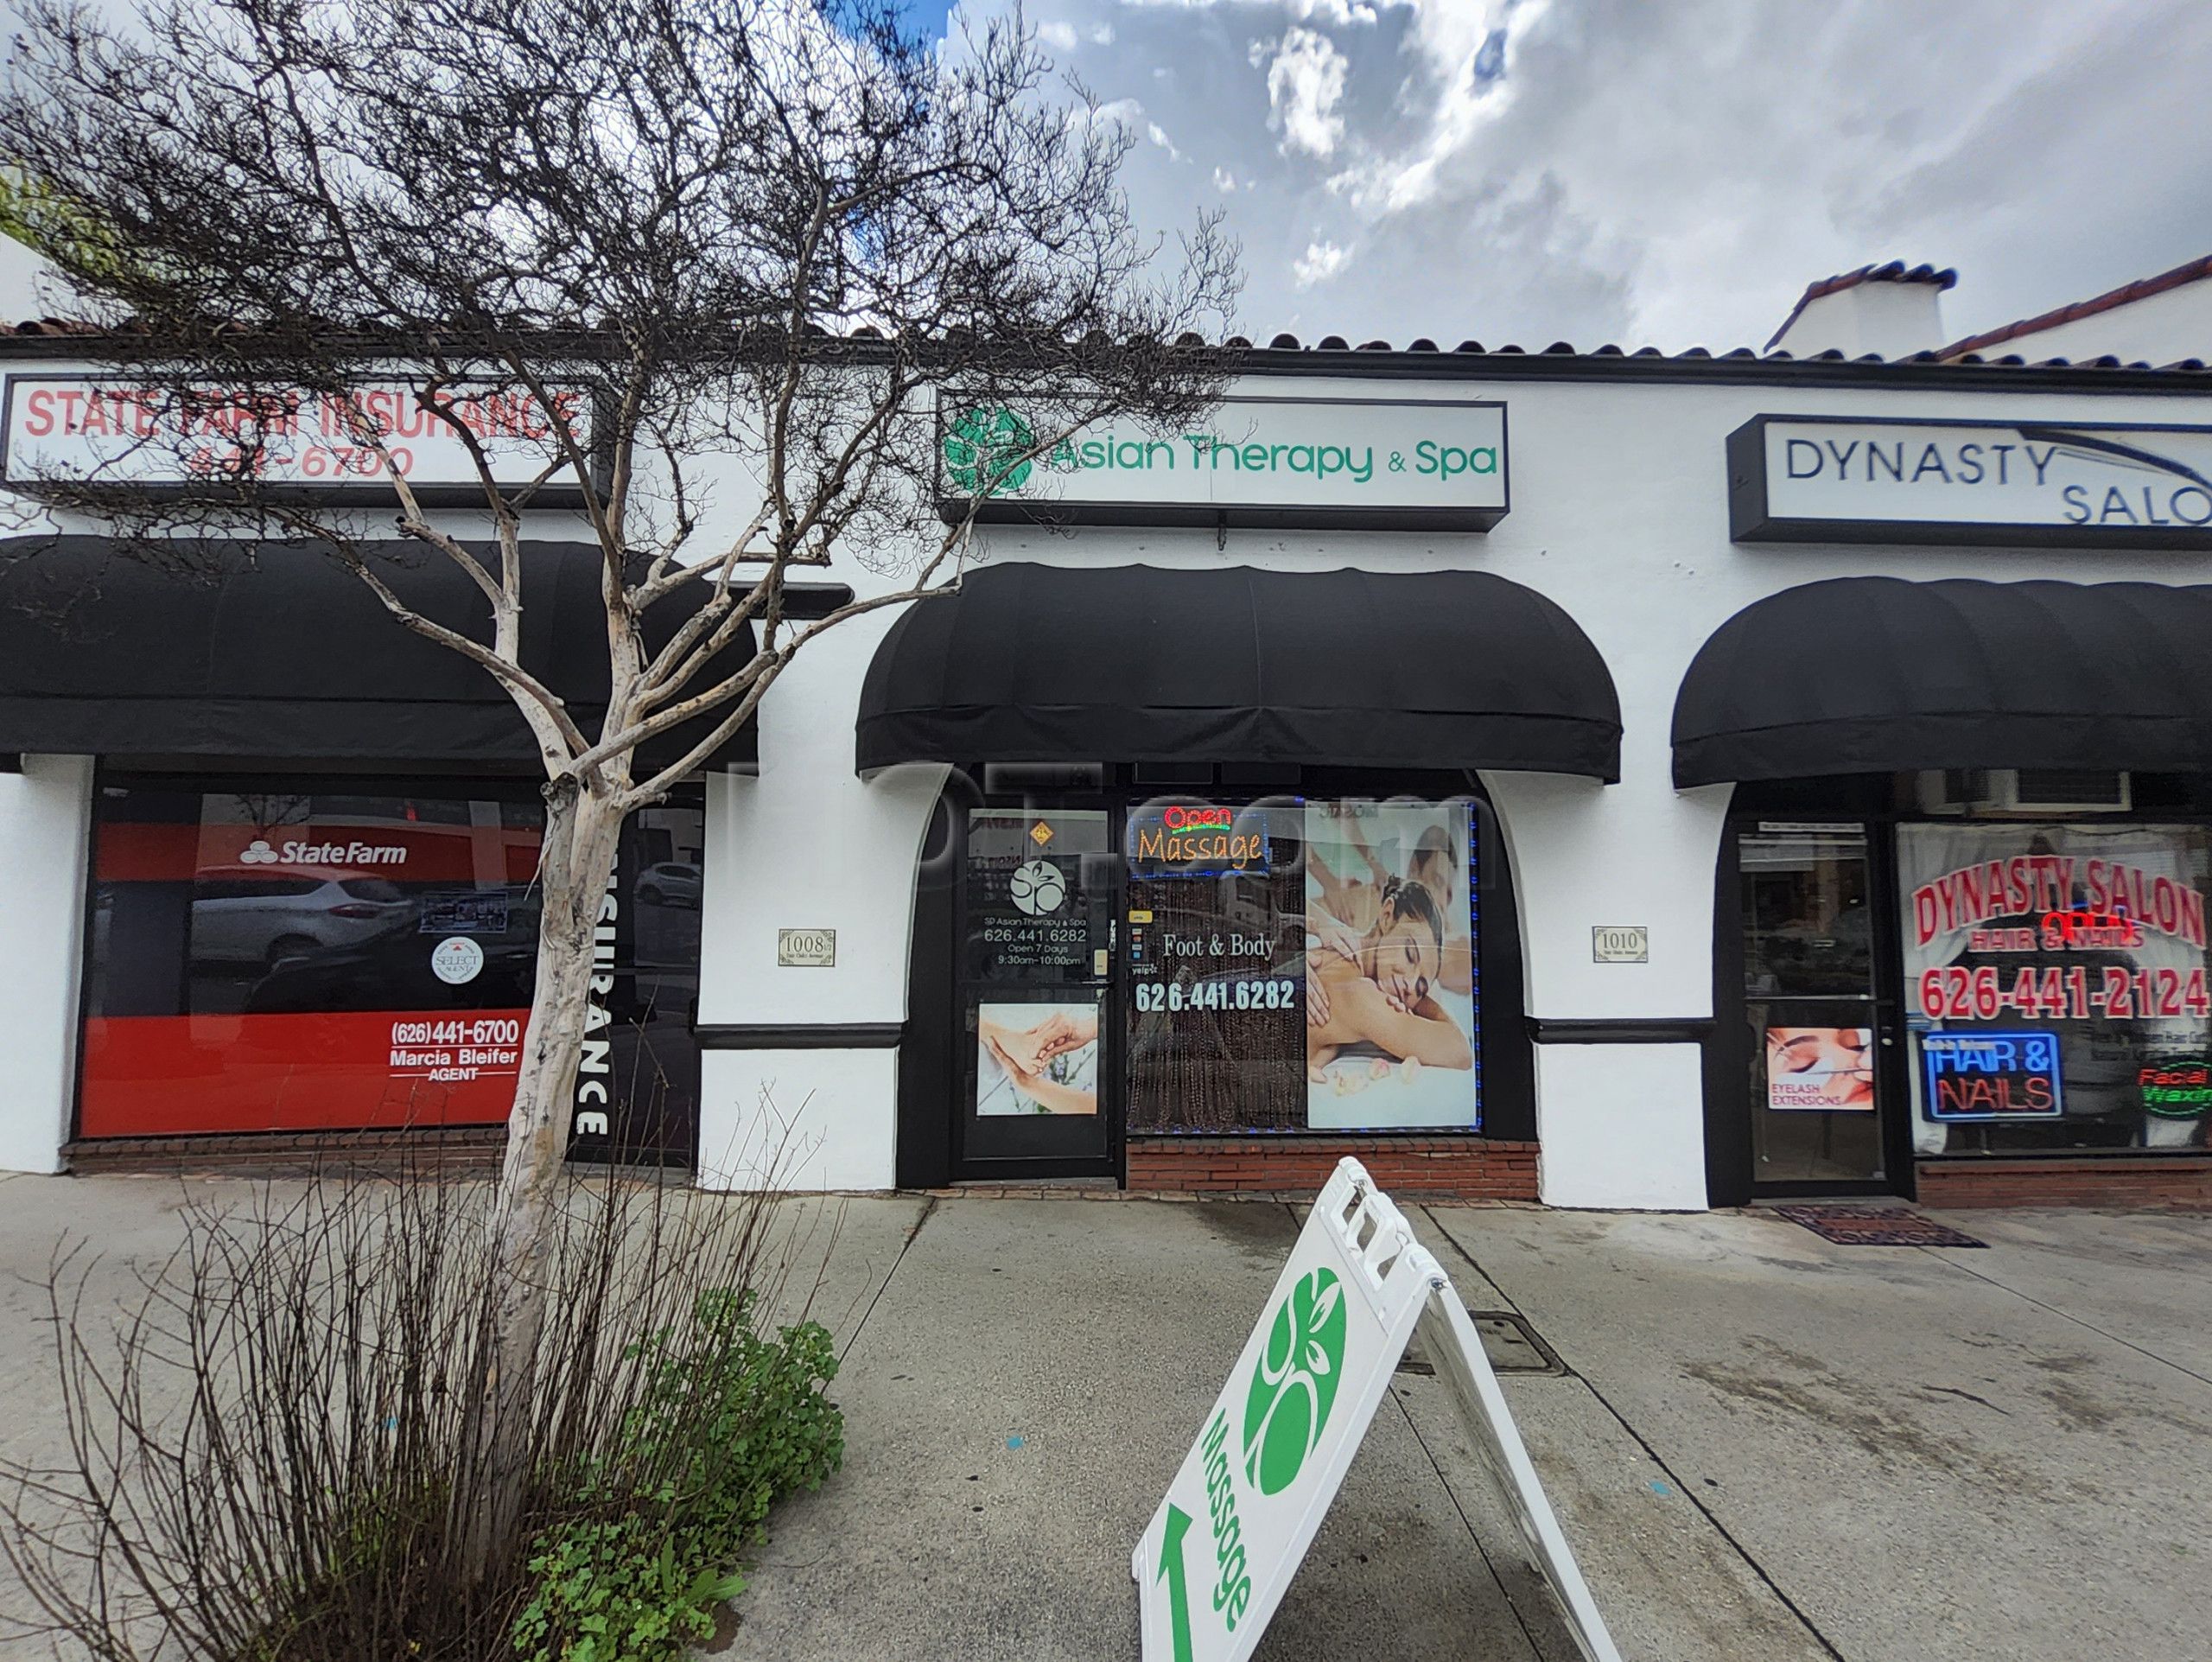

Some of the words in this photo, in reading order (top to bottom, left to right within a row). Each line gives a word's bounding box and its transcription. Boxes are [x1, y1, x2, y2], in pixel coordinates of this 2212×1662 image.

[1182, 435, 1373, 483] Therapy
[1388, 450, 1408, 474] &
[1415, 440, 1497, 481] Spa
[1786, 439, 2058, 486] DYNASTY
[1165, 806, 1230, 828] Open
[1138, 828, 1262, 869] Massage
[1910, 855, 2075, 947] DYNASTY
[2085, 858, 2207, 951] SALON
[1023, 917, 1061, 927] Therapy
[1069, 918, 1087, 927] Spa
[787, 936, 823, 952] 1008
[984, 929, 1086, 942] 626.441.6282
[1163, 933, 1204, 957] Foot
[1209, 933, 1225, 956] &
[1230, 933, 1276, 961] Body
[1604, 933, 1637, 948] 1010
[1967, 928, 2037, 952] HAIR
[1007, 944, 1033, 953] Open
[1036, 944, 1042, 952] 7
[1045, 945, 1068, 954] Days
[1135, 981, 1294, 1012] 626.441.6282
[1920, 966, 2210, 1020] 626-441-2124
[390, 1050, 451, 1067] Marcia
[458, 1048, 518, 1065] Bleifer
[1936, 1041, 2016, 1073] HAIR
[2024, 1040, 2050, 1072] &
[429, 1067, 478, 1080] AGENT
[1771, 1084, 1821, 1093] EYELASH
[1771, 1095, 1841, 1105] EXTENSIONS
[1937, 1077, 2053, 1110] NAILS
[1202, 1407, 1251, 1632] Massage
